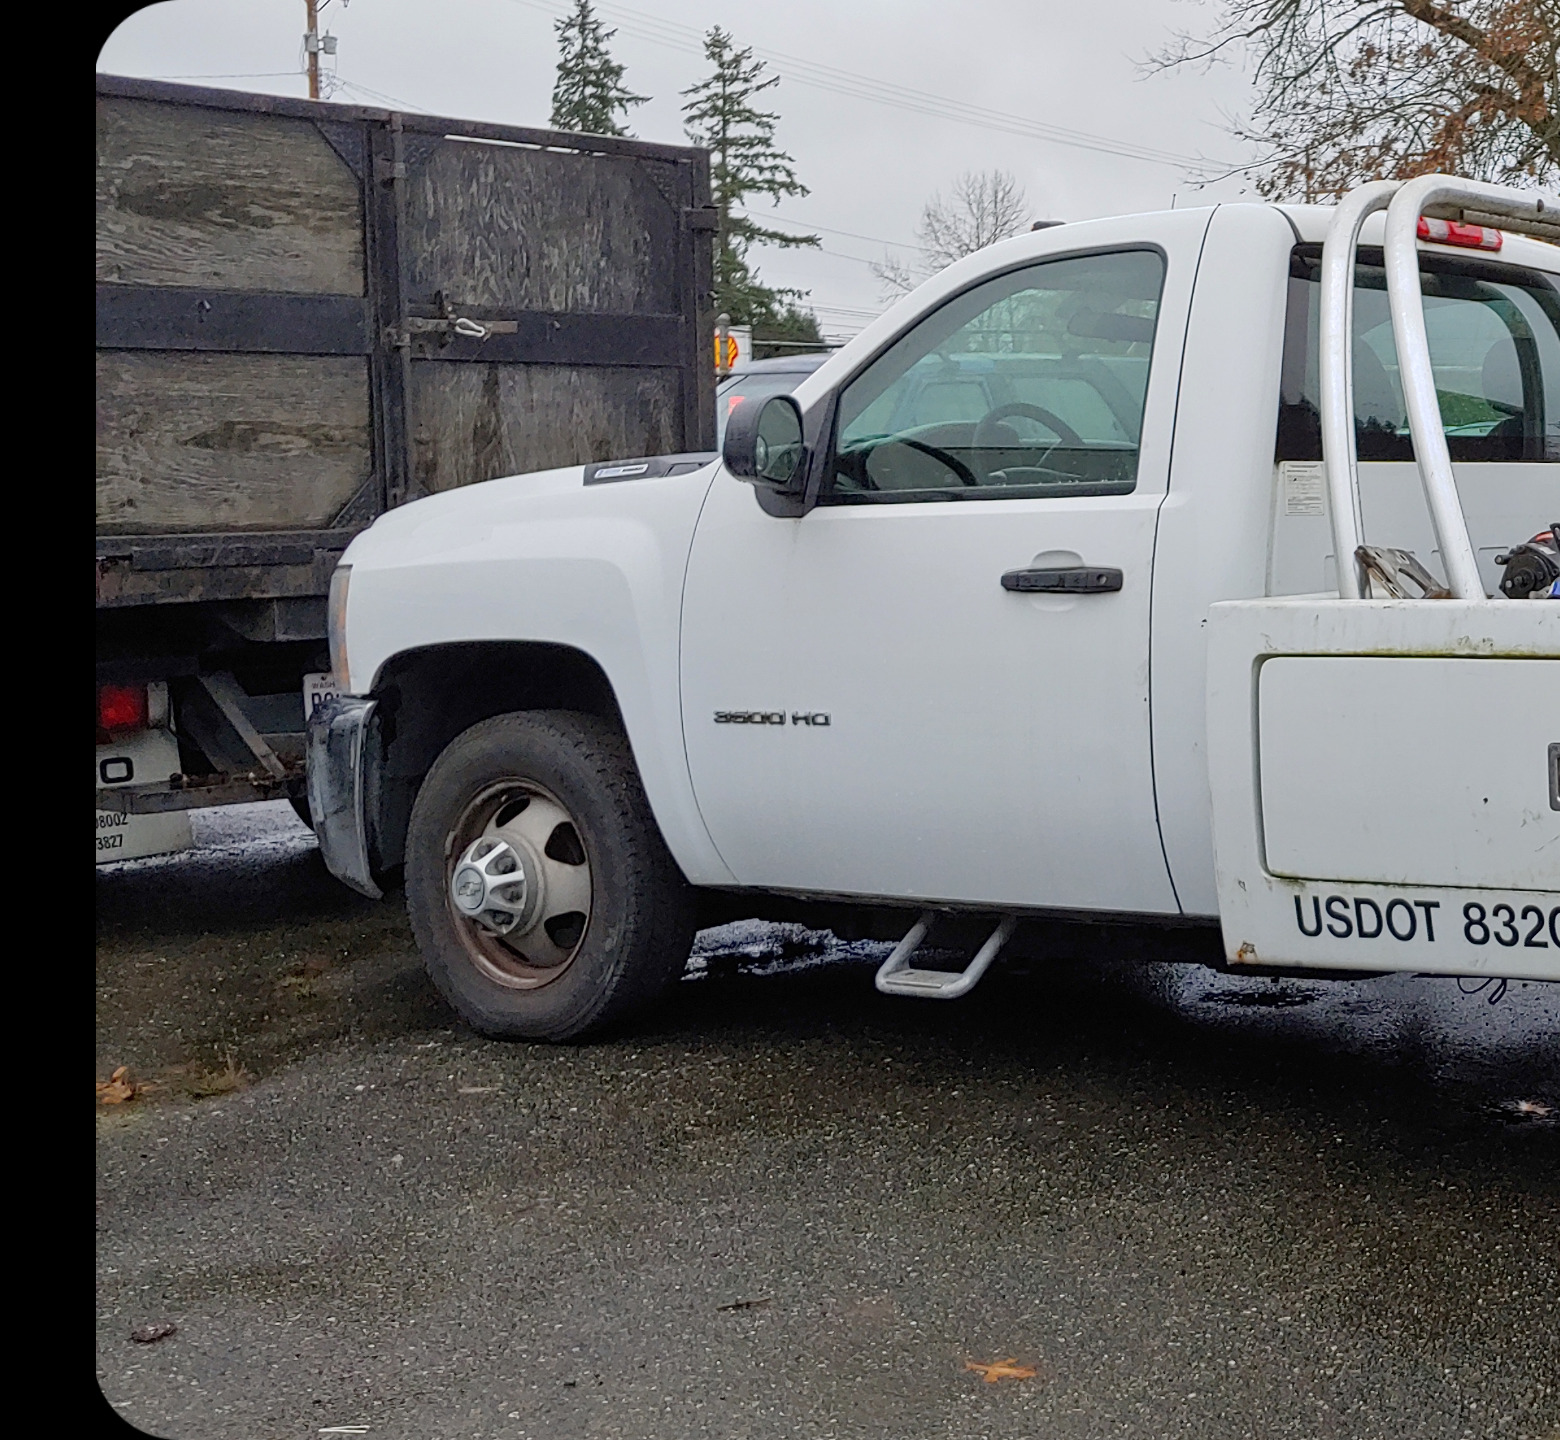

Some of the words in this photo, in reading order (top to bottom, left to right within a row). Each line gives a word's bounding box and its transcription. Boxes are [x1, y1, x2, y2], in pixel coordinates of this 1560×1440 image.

[713, 710, 786, 726] 3500
[792, 711, 831, 726] HD
[96, 834, 123, 850] 3827
[1294, 894, 1440, 942] USDOT
